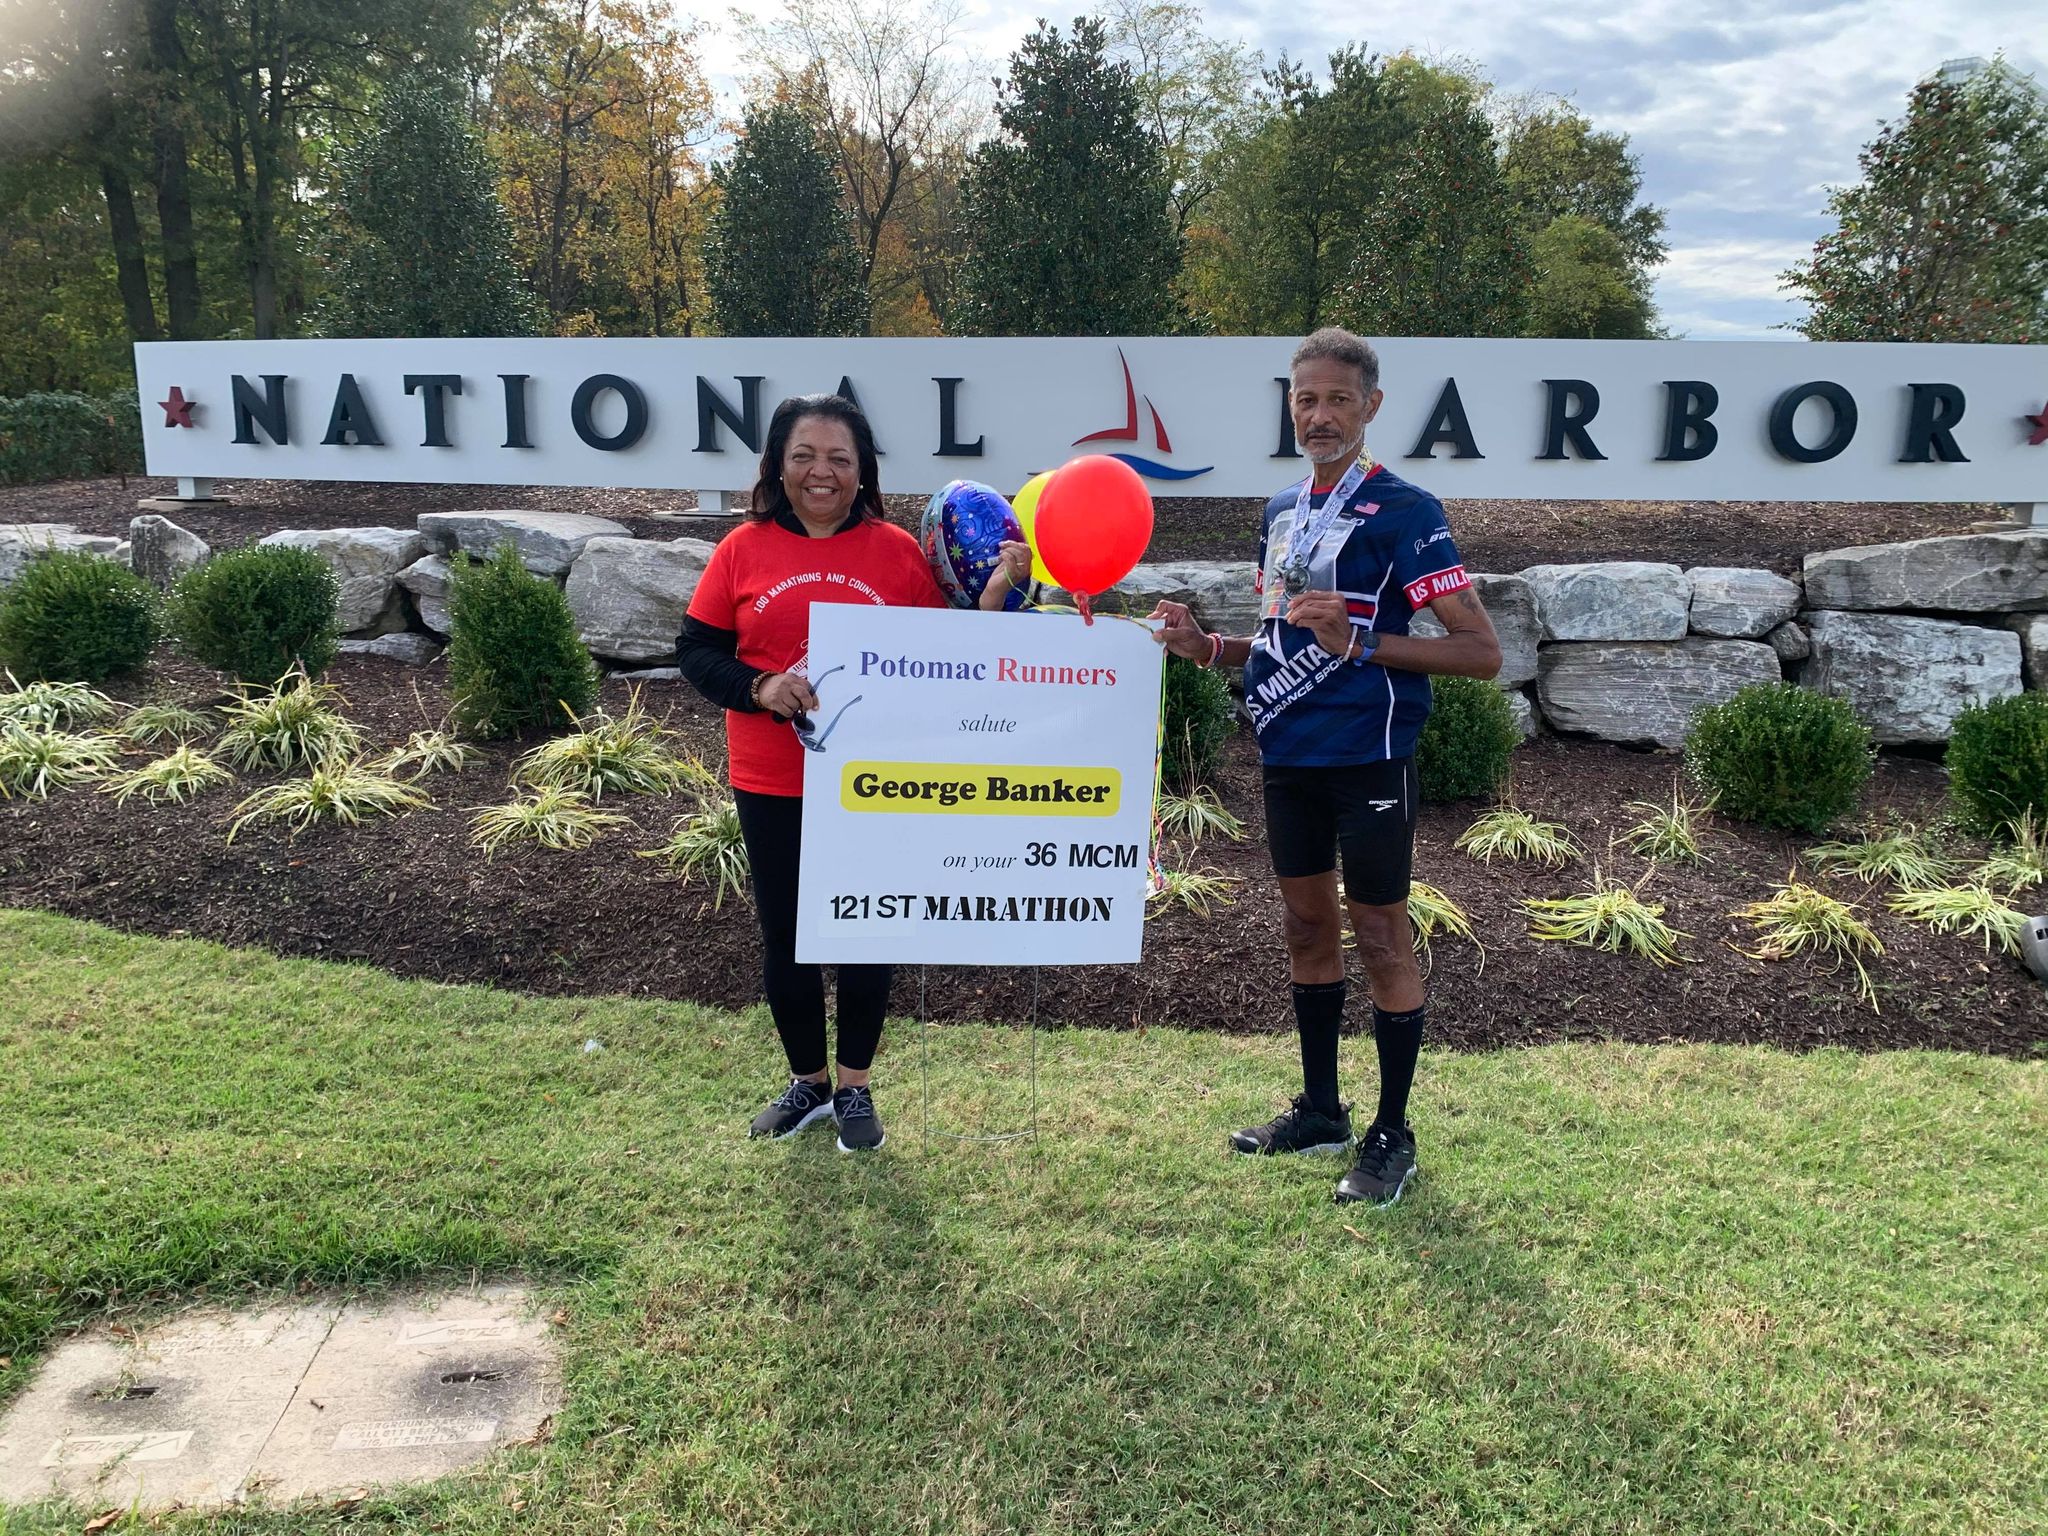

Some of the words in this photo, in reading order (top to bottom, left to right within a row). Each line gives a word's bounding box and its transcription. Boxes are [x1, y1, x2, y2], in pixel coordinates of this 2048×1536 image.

[753, 595, 770, 614] 100
[767, 572, 822, 598] MARATHONS
[826, 572, 846, 584] AND
[1409, 582, 1429, 602] US
[859, 651, 986, 682] Potomac
[996, 657, 1117, 687] Runners
[1257, 643, 1331, 705] MILITA
[958, 714, 1017, 733] salute
[1255, 680, 1315, 736] ENDURANCE
[853, 773, 977, 806] George
[986, 777, 1111, 803] Banker
[943, 855, 967, 868] on
[970, 855, 1017, 873] your
[1024, 842, 1057, 867] 36
[1068, 844, 1138, 868] MCM
[923, 896, 1113, 922] MARATHON
